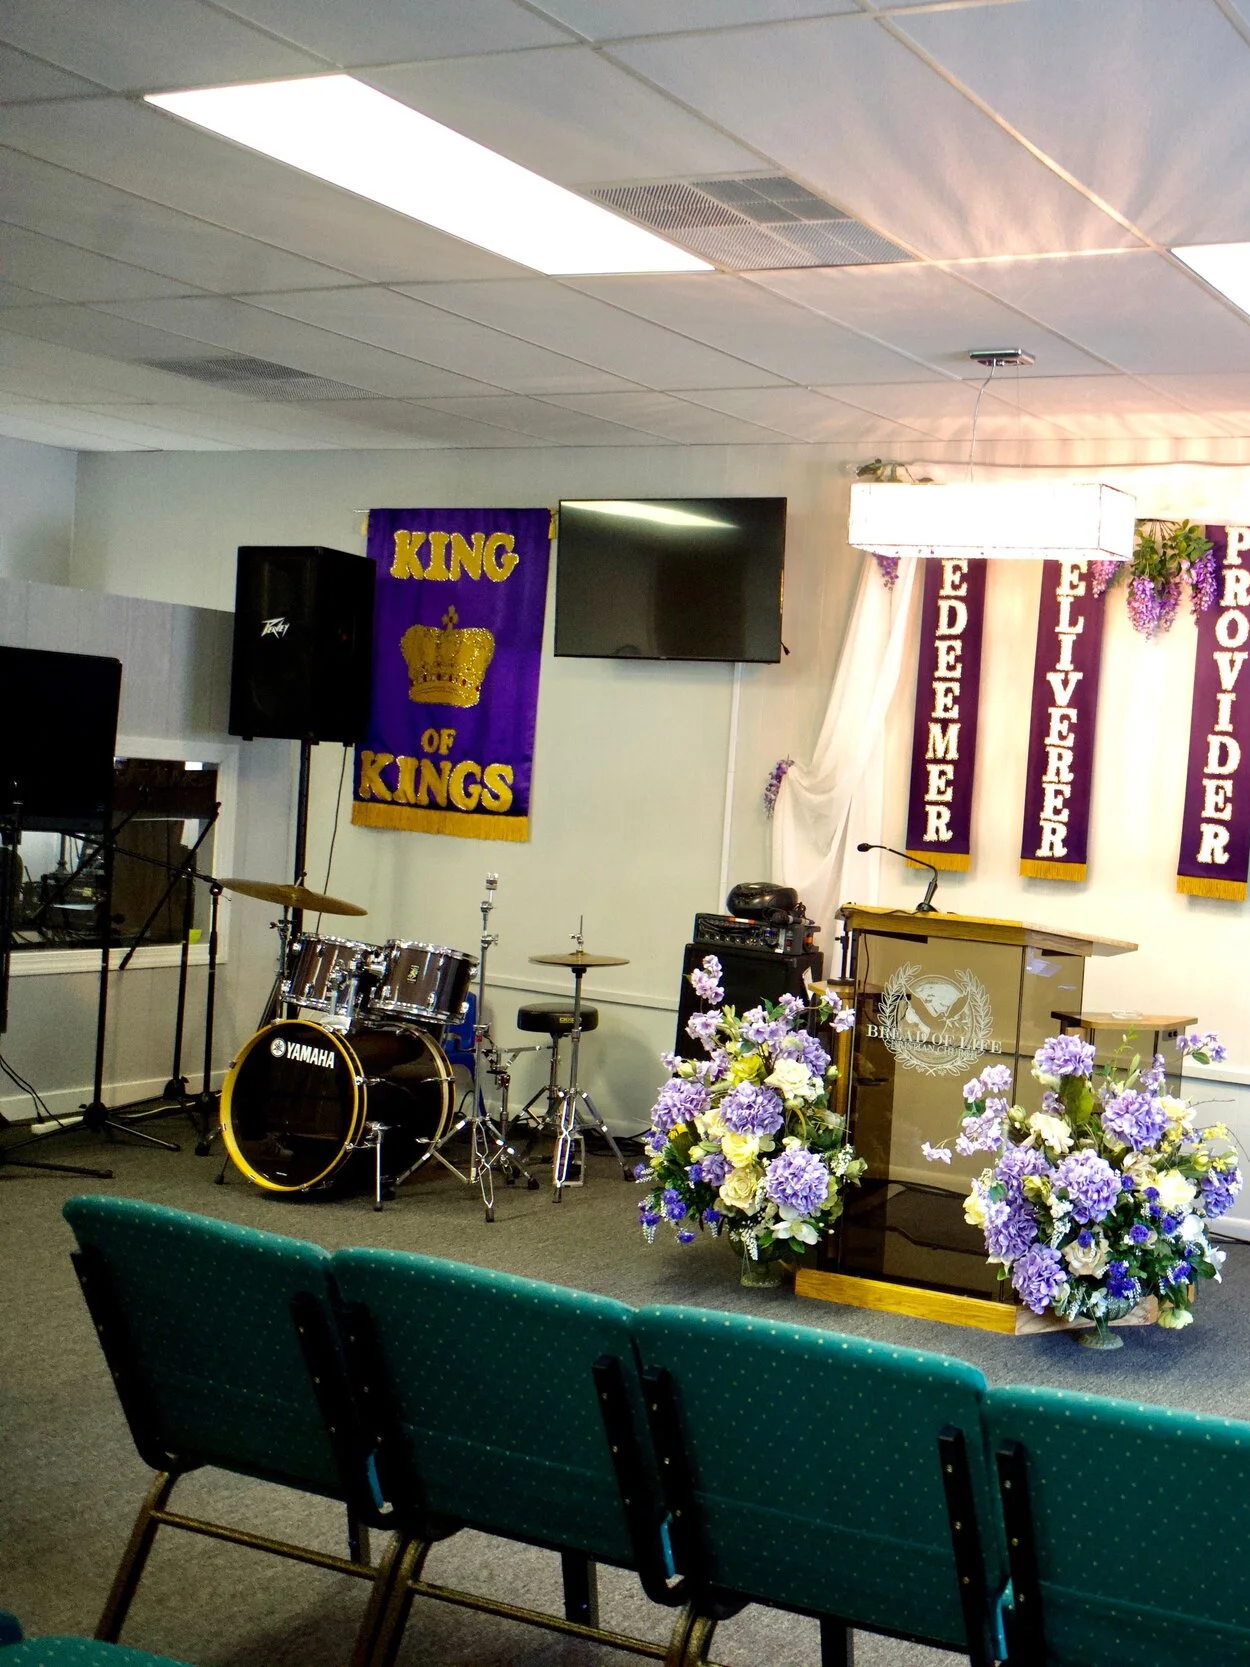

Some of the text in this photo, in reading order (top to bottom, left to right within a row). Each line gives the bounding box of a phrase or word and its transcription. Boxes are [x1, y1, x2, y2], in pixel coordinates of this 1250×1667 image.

[389, 529, 519, 582] KING
[922, 559, 969, 842] EDEEMER
[1035, 559, 1088, 858] ELIVERER
[420, 727, 457, 755] OF
[358, 750, 514, 812] KINGS
[286, 1041, 335, 1069] YAMAHA
[866, 1023, 1002, 1054] BREAD OF LIFE
